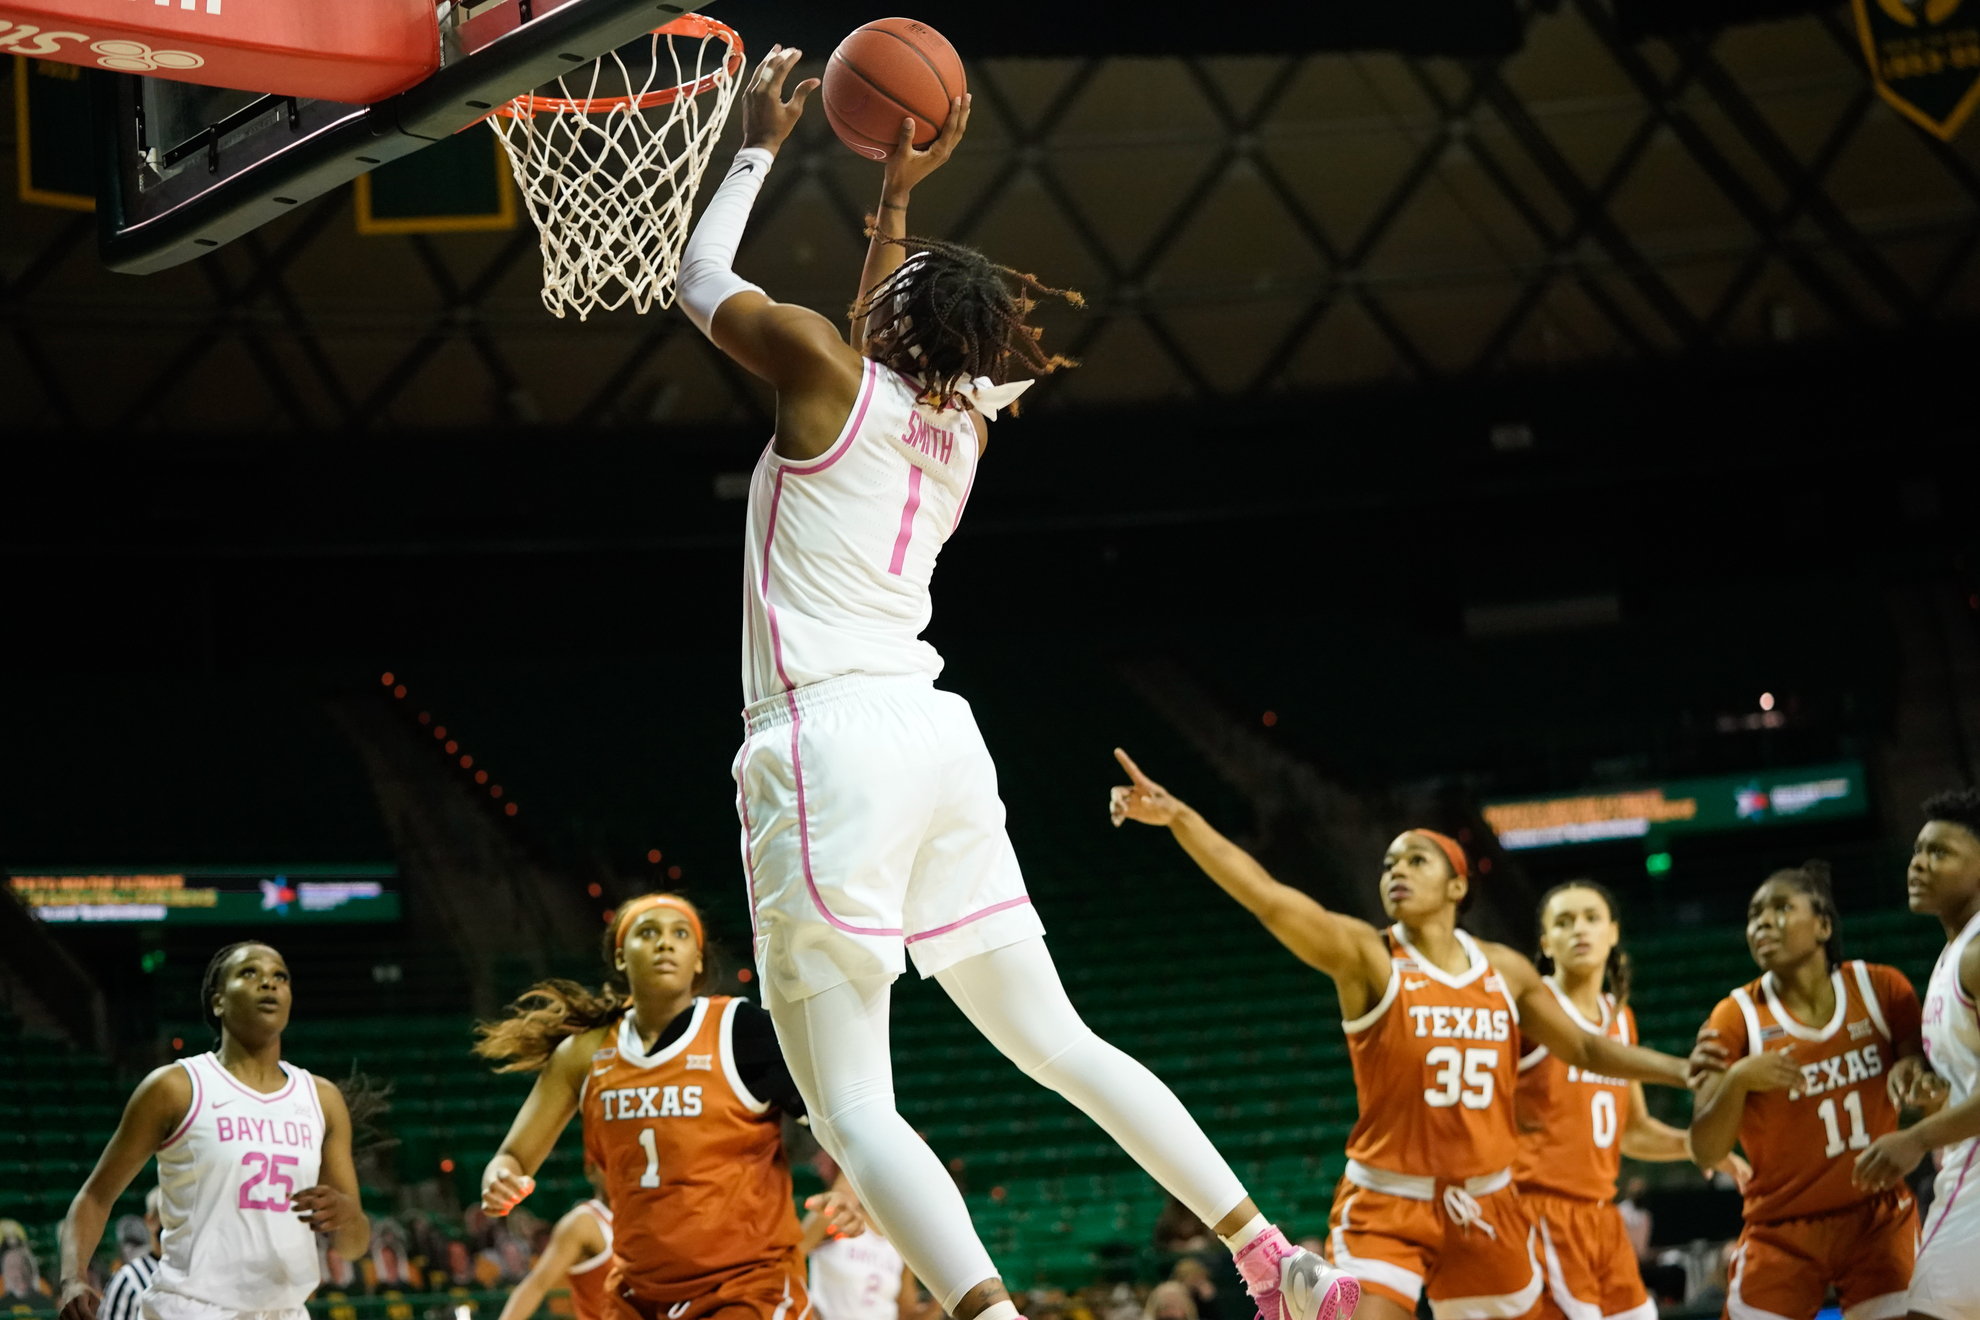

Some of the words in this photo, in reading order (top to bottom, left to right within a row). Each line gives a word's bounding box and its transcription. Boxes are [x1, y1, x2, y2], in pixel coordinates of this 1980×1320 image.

[902, 410, 954, 465] SMITH
[888, 464, 923, 576] 1
[1409, 1005, 1509, 1042] TEXAS
[1424, 1046, 1498, 1110] 35
[1788, 1043, 1883, 1101] EXAS
[600, 1085, 703, 1121] TEXAS
[1591, 1090, 1617, 1149] 0
[1817, 1090, 1871, 1158] 11
[216, 1117, 313, 1149] BAYLOR
[638, 1127, 661, 1189] 1
[239, 1152, 299, 1212] 25
